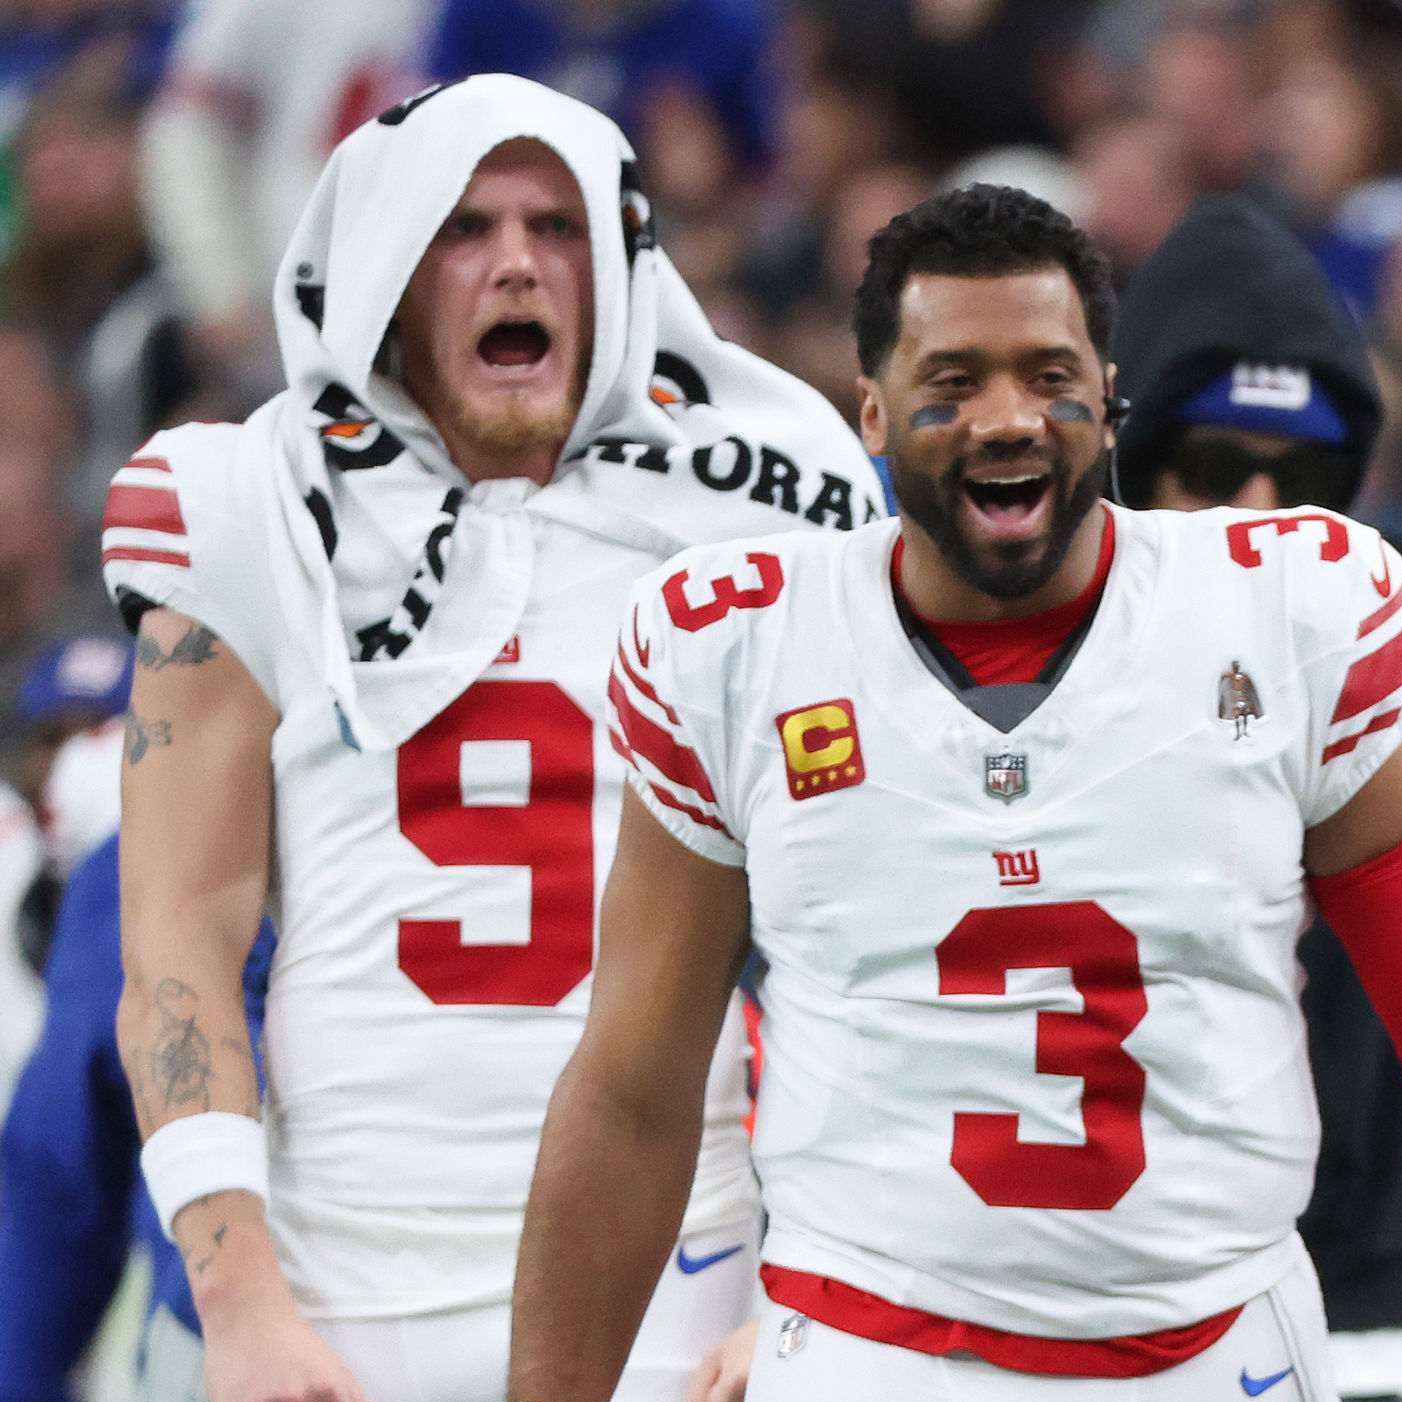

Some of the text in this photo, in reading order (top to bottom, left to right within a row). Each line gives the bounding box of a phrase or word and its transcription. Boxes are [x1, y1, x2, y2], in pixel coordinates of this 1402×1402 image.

[661, 552, 784, 633] 3
[782, 705, 855, 774] C
[398, 680, 594, 1006] 9
[934, 900, 1147, 1211] 3
